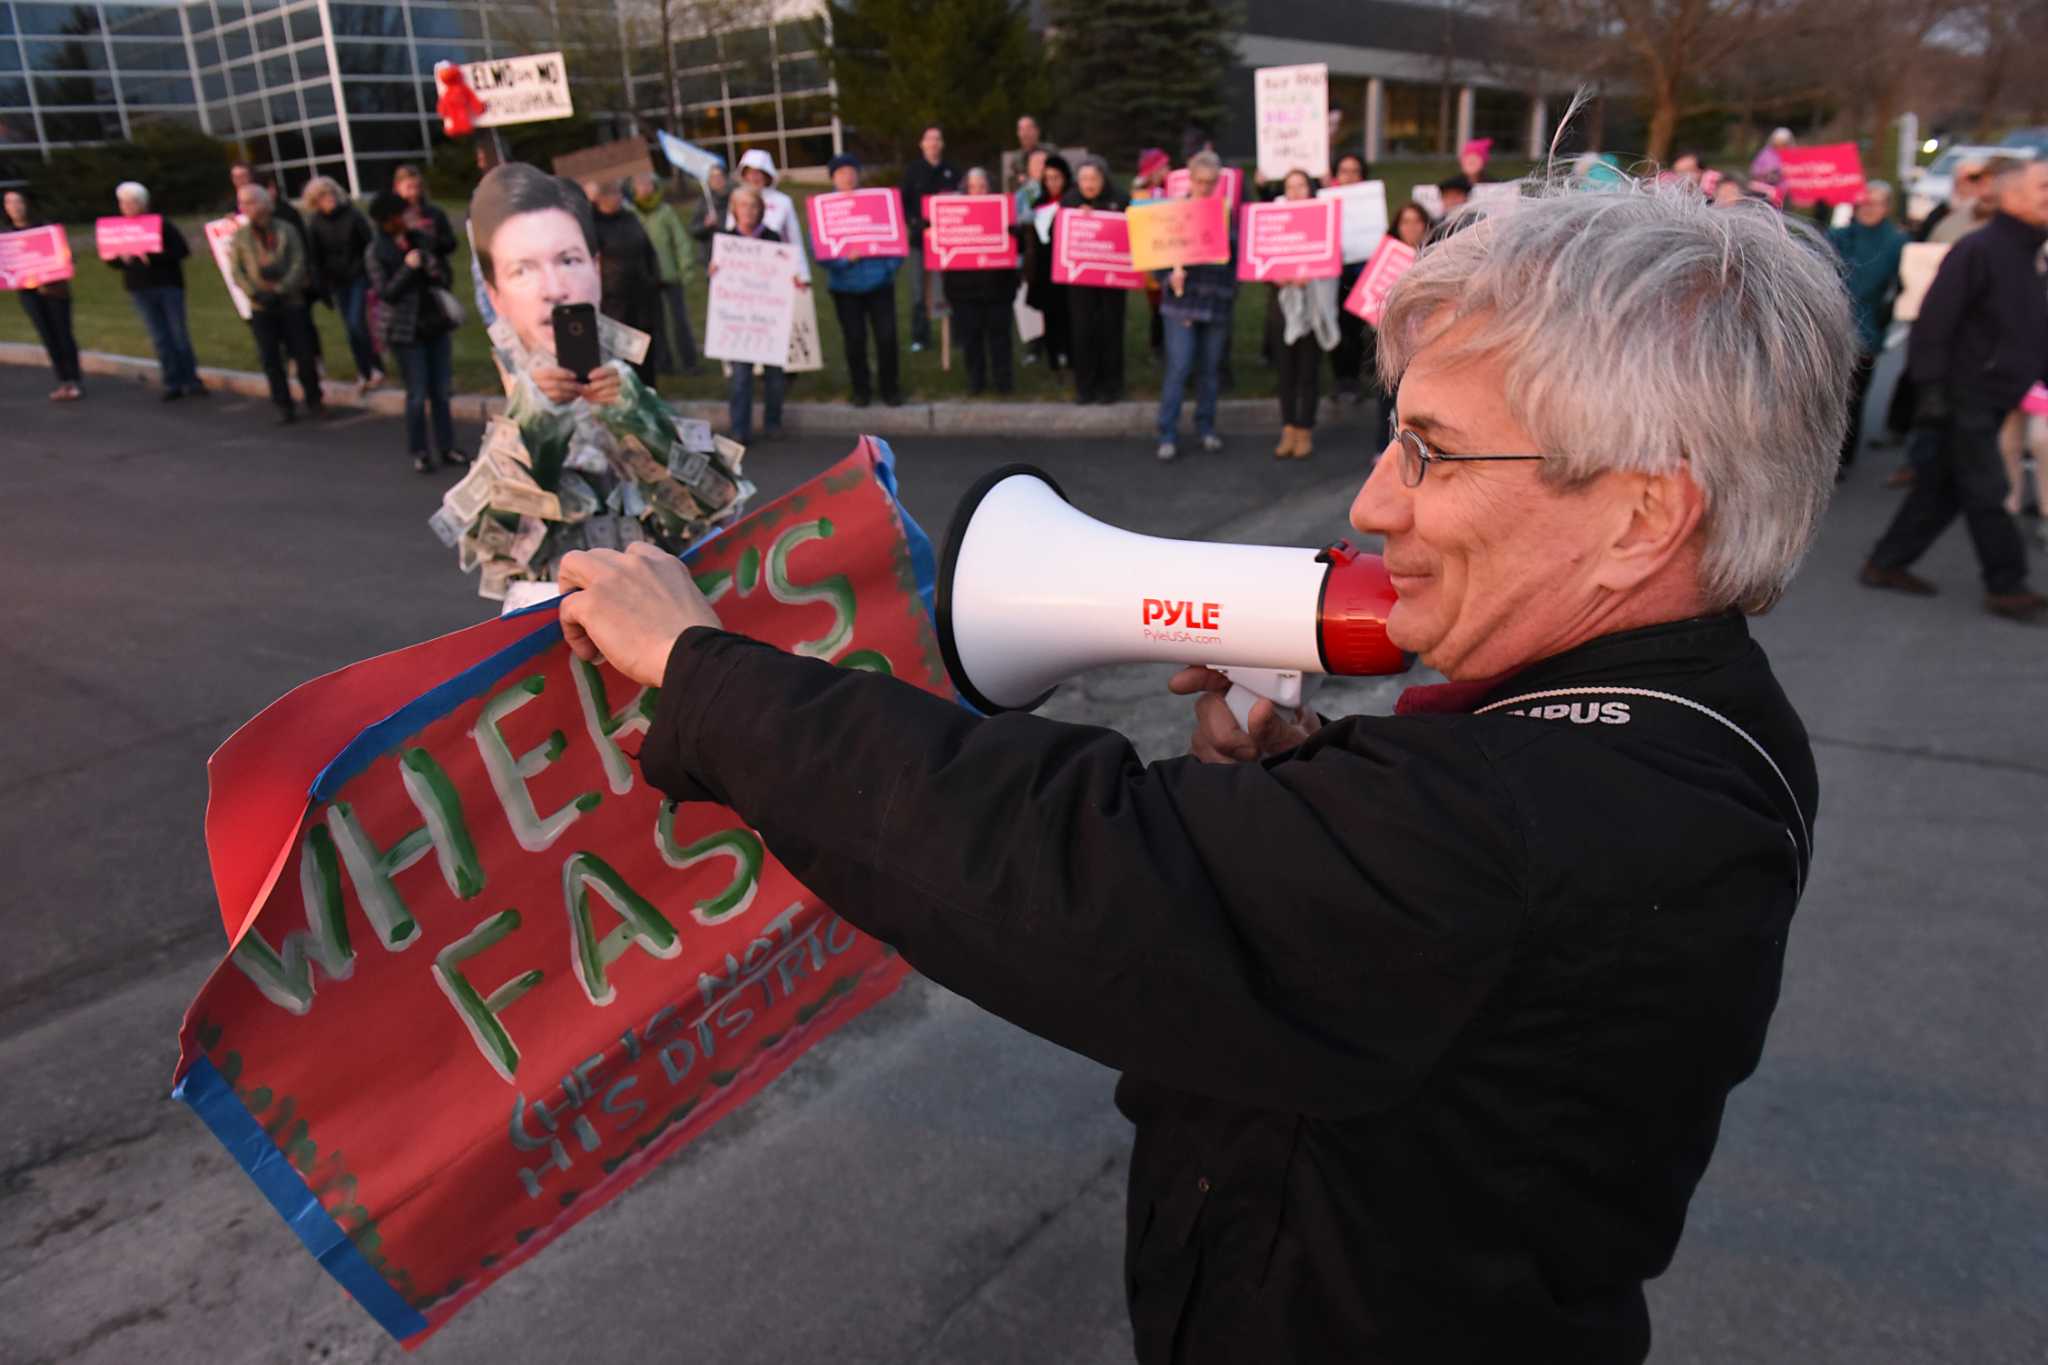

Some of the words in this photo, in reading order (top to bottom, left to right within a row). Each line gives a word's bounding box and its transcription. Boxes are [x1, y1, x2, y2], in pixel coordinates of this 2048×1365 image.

[1143, 598, 1220, 630] PYLE
[231, 517, 857, 1015] WHE'S
[1505, 701, 1631, 724] PUS
[432, 798, 766, 1085] FAS
[658, 912, 857, 1085] DISTRIC
